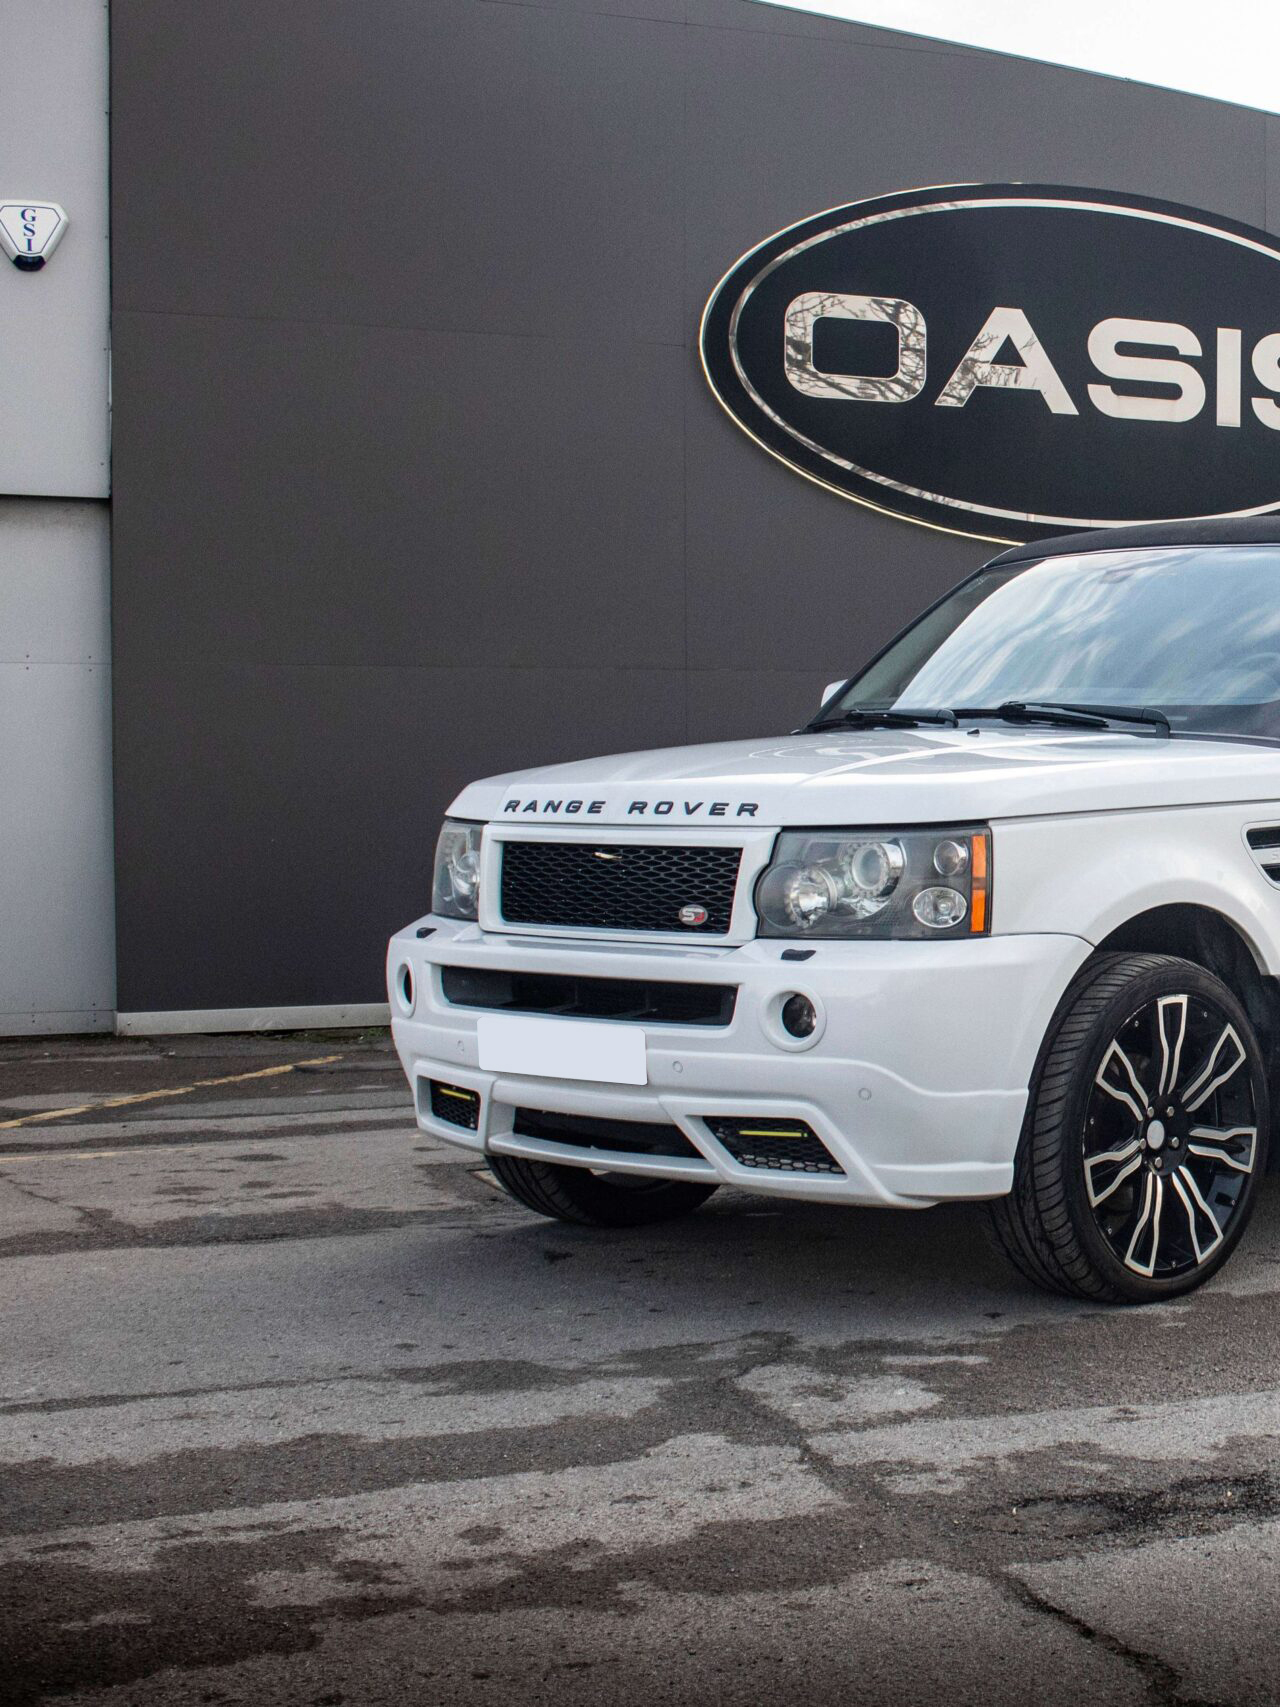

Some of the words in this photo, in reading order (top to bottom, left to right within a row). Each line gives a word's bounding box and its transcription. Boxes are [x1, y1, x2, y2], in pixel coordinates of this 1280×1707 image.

[20, 208, 37, 252] GSI
[504, 800, 606, 814] RANGE
[628, 800, 760, 817] ROVER
